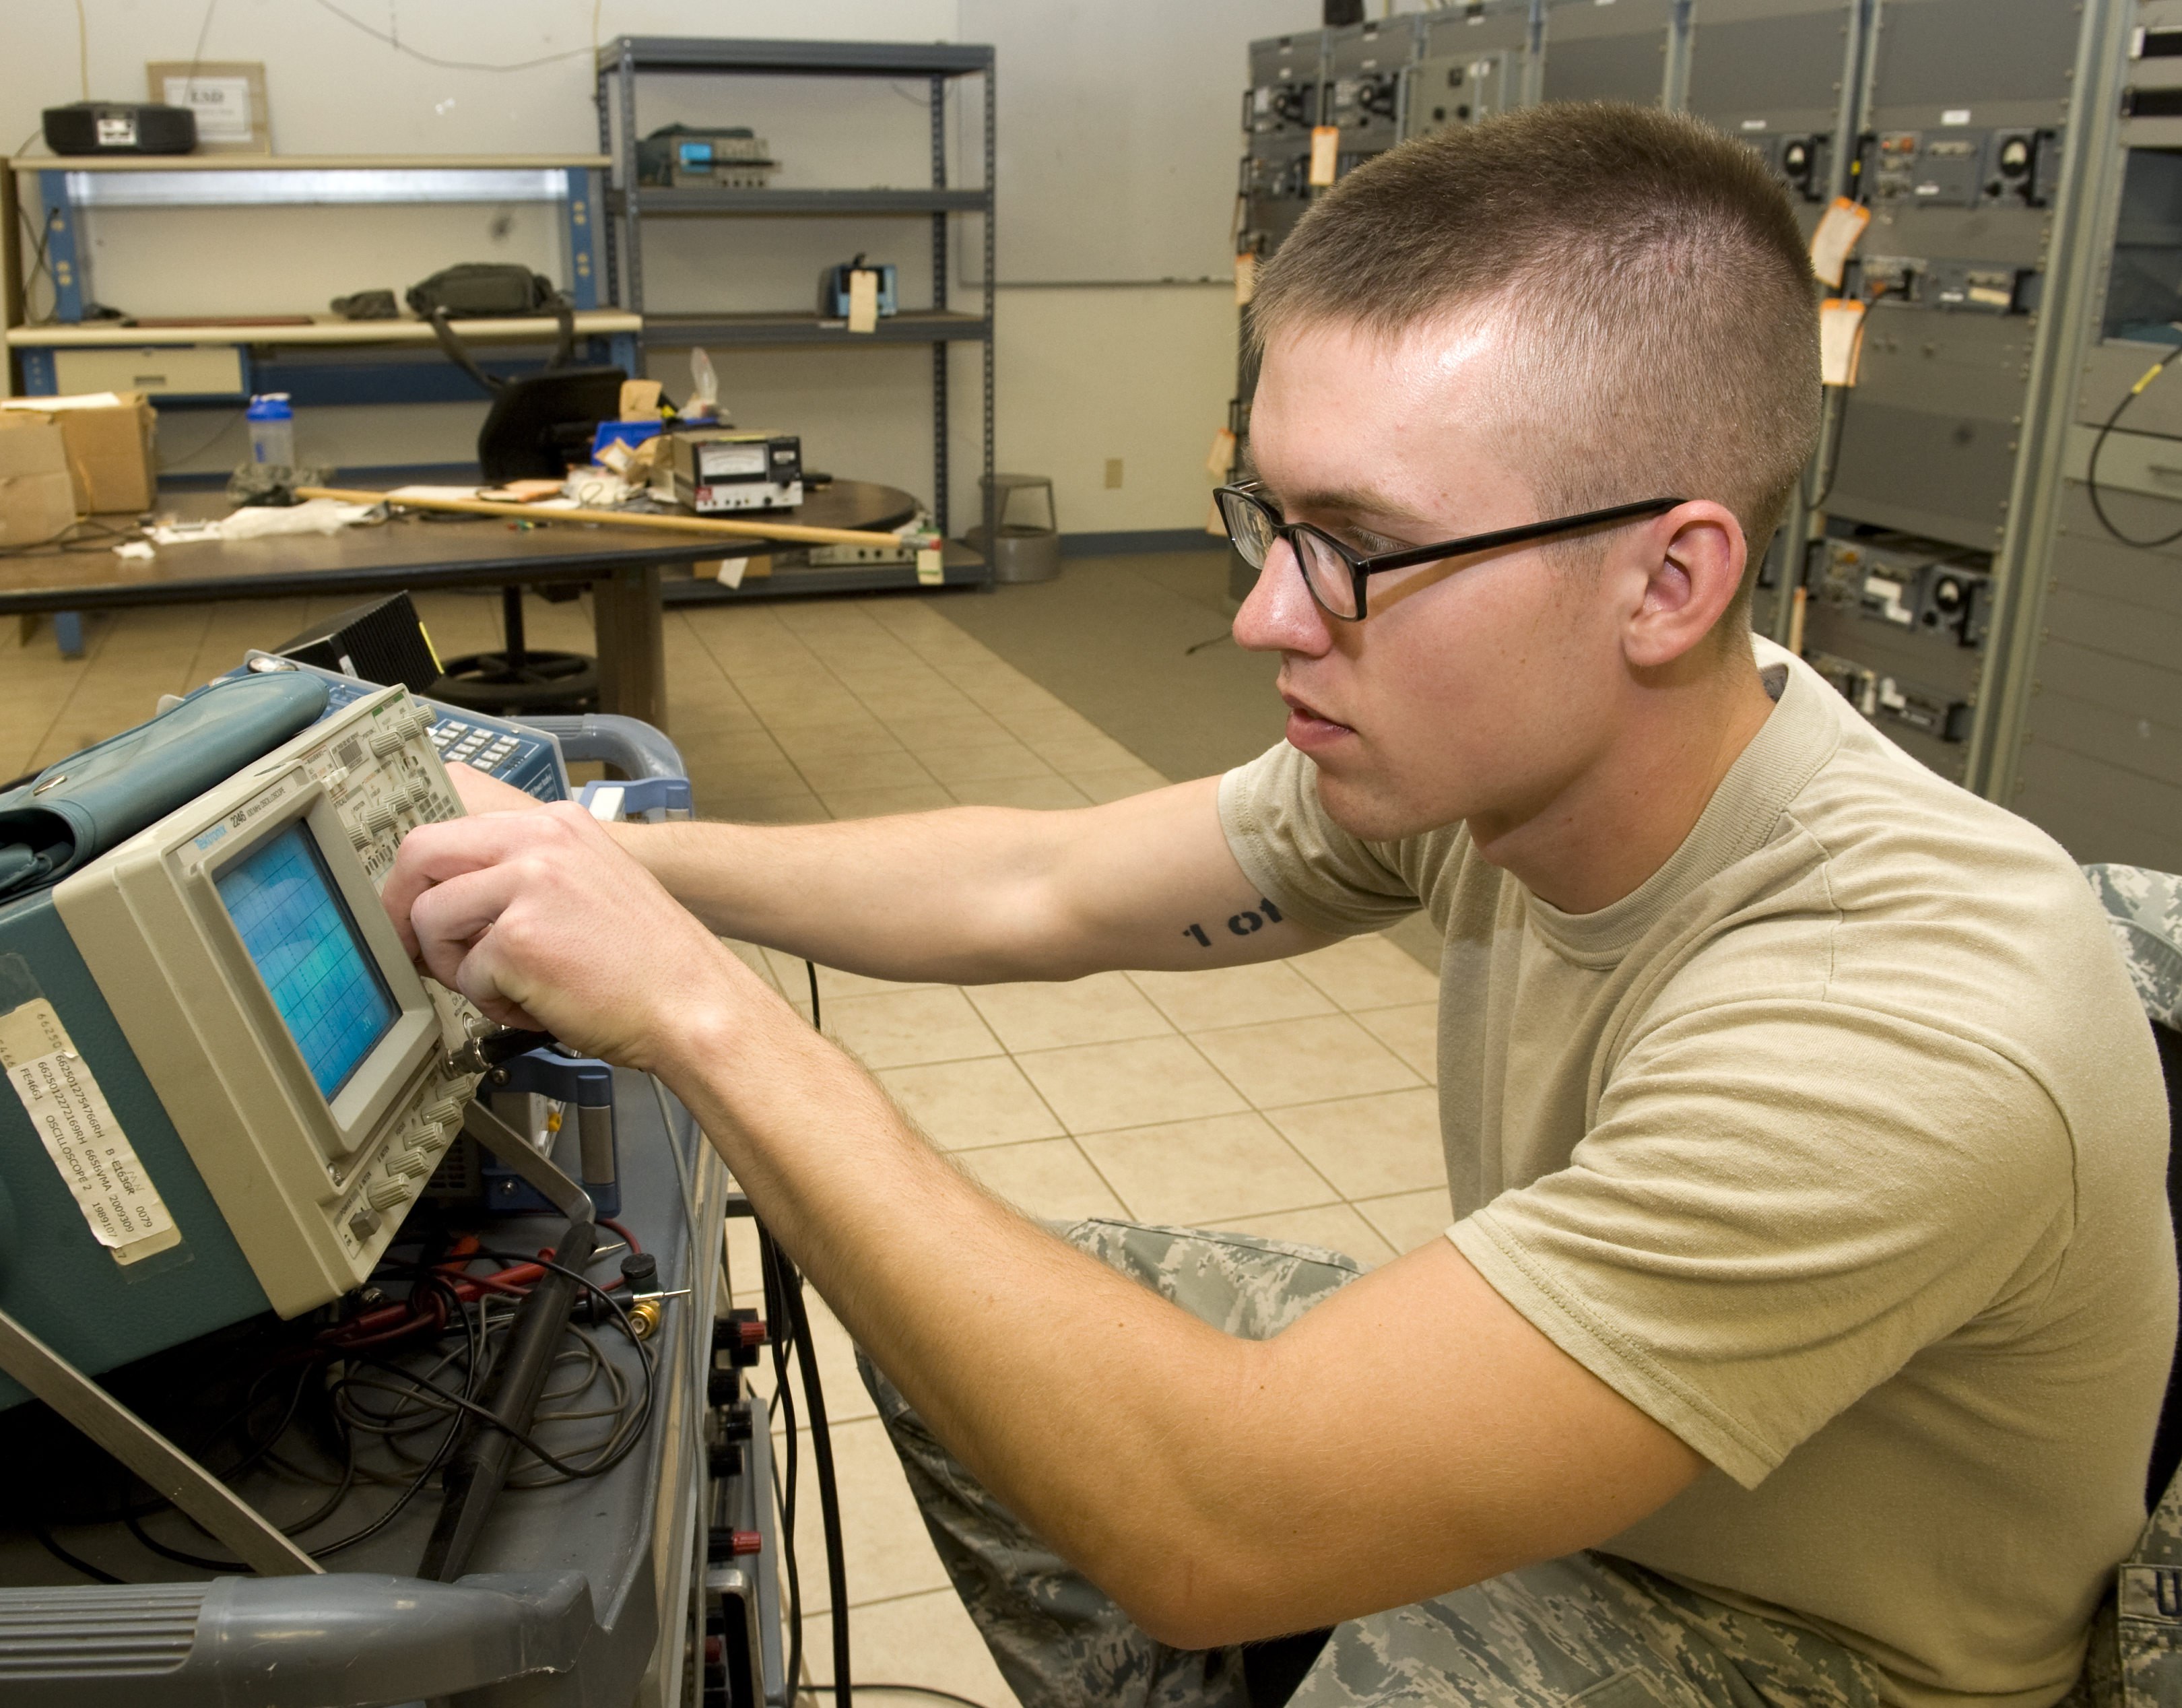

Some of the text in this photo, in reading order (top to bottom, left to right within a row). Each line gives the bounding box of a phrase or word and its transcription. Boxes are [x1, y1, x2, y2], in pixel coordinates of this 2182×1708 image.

[195, 826, 227, 851] Tektronix
[230, 810, 246, 828] 2246
[37, 1013, 66, 1053] 66250
[38, 1061, 88, 1145] 6625012272169RH
[109, 1195, 135, 1233] 2009309
[55, 1055, 105, 1138] 6625012754766RH
[105, 1148, 115, 1156] B
[135, 1206, 153, 1228] 0079
[395, 1122, 406, 1136] FOCUS
[20, 1068, 43, 1102] FE4661
[46, 1115, 88, 1183] OSCILLOSCOPE
[92, 1202, 118, 1238] 1989107
[380, 1146, 390, 1160] INTEN
[362, 1171, 372, 1187] INTEN
[339, 1198, 353, 1216] POWER
